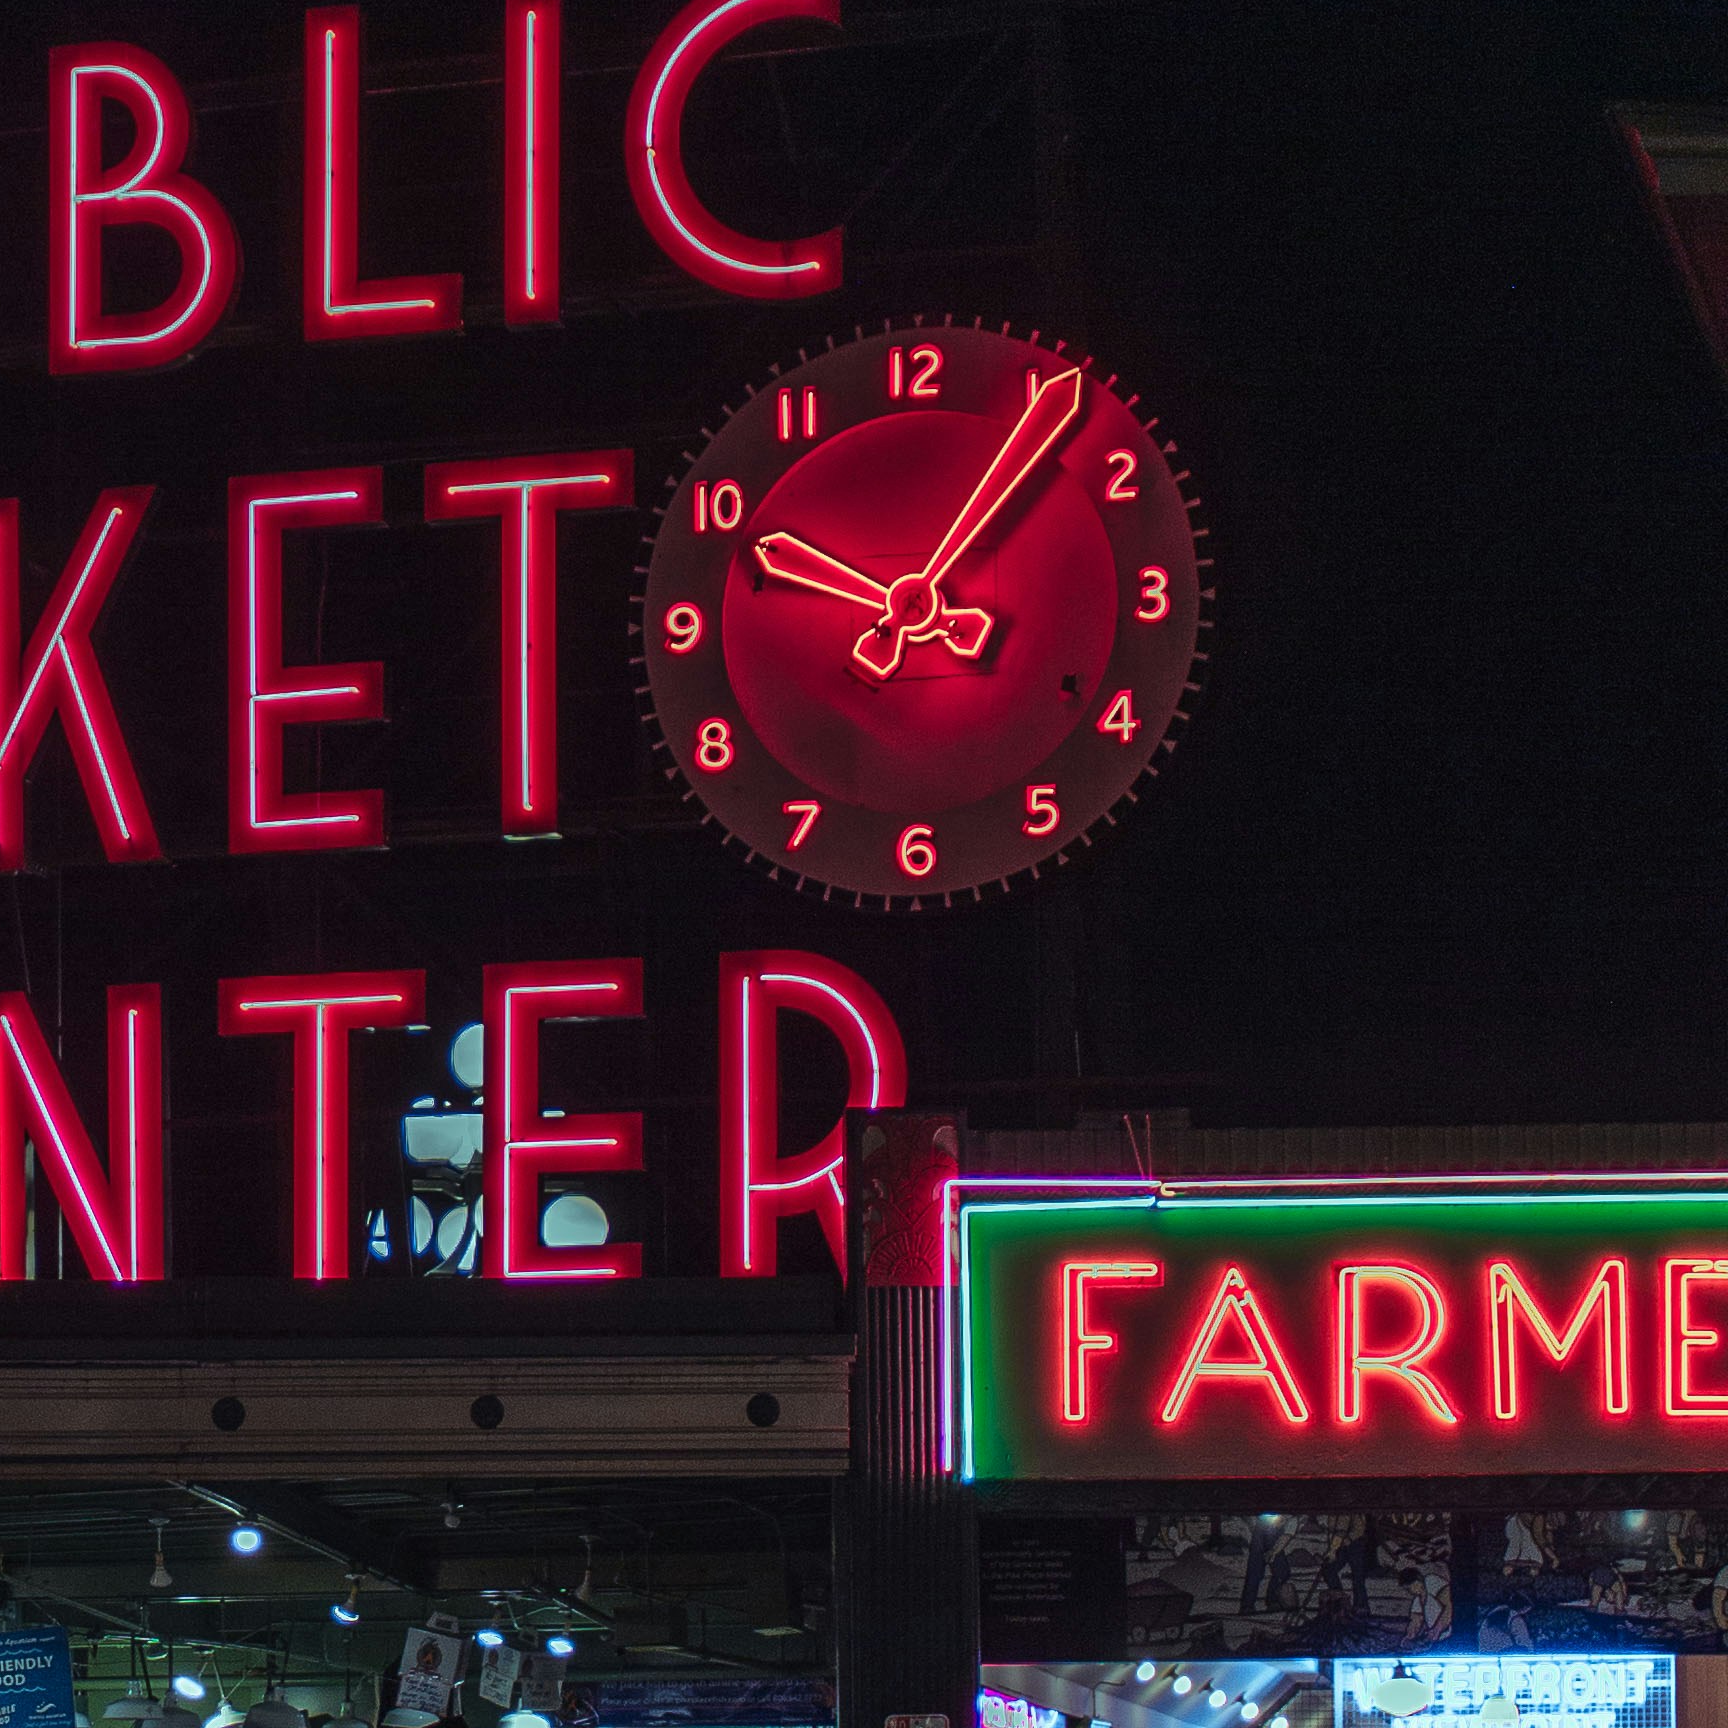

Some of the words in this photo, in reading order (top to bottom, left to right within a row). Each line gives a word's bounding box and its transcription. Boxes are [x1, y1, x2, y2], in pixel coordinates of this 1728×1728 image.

[889, 346, 943, 399] 12
[777, 387, 816, 442] 11
[1106, 449, 1140, 501] 2
[694, 479, 744, 532] 10
[1136, 565, 1170, 622] 3
[665, 603, 704, 653] 9
[1096, 690, 1141, 742] 4
[695, 718, 735, 772] 8
[783, 800, 821, 850] 7
[1022, 784, 1061, 836] 5
[897, 824, 937, 877] 6
[1352, 1660, 1656, 1713] WTERFRONT
